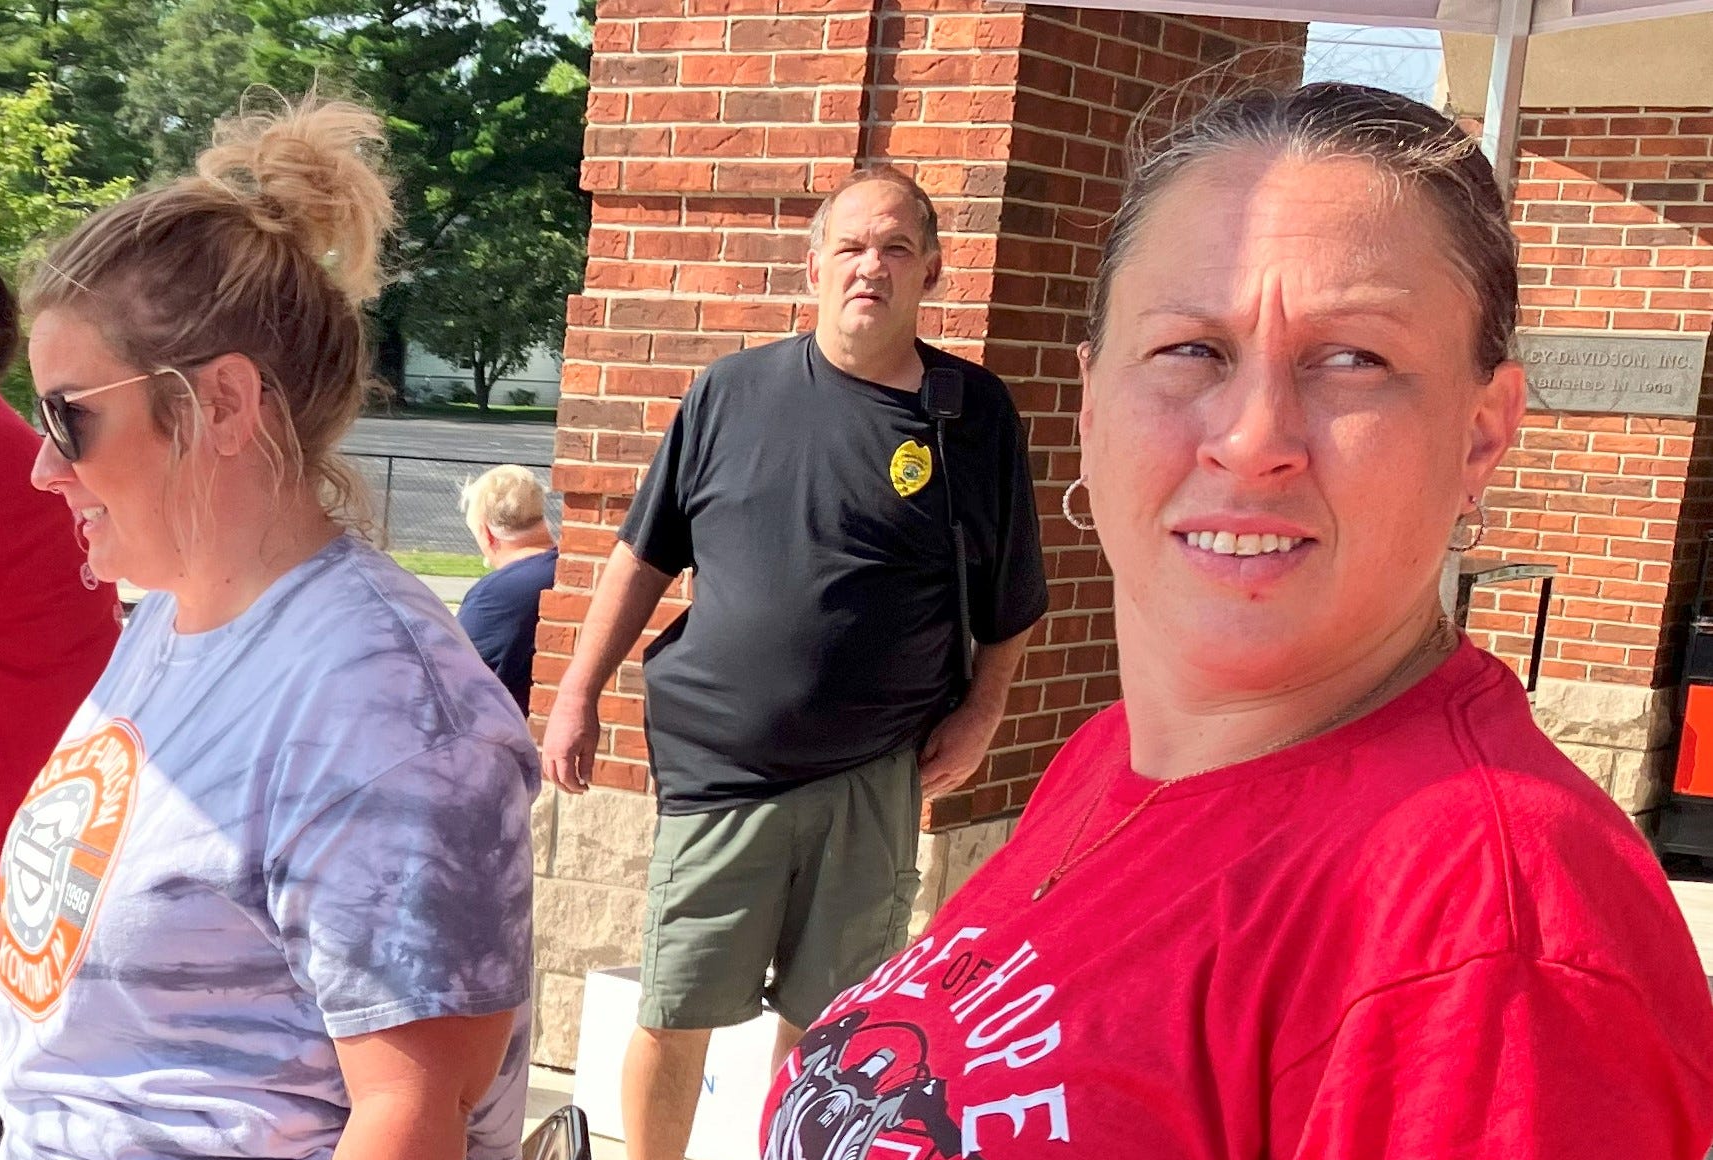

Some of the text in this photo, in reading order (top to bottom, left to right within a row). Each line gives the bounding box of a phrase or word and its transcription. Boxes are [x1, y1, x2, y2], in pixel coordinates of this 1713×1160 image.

[1526, 349, 1695, 370] EY-DAVIDSON, INC.
[1613, 379, 1629, 393] IN
[1638, 381, 1673, 394] 1903
[63, 880, 91, 916] 1998
[940, 951, 995, 997] OF
[948, 938, 1071, 1160] HOPE
